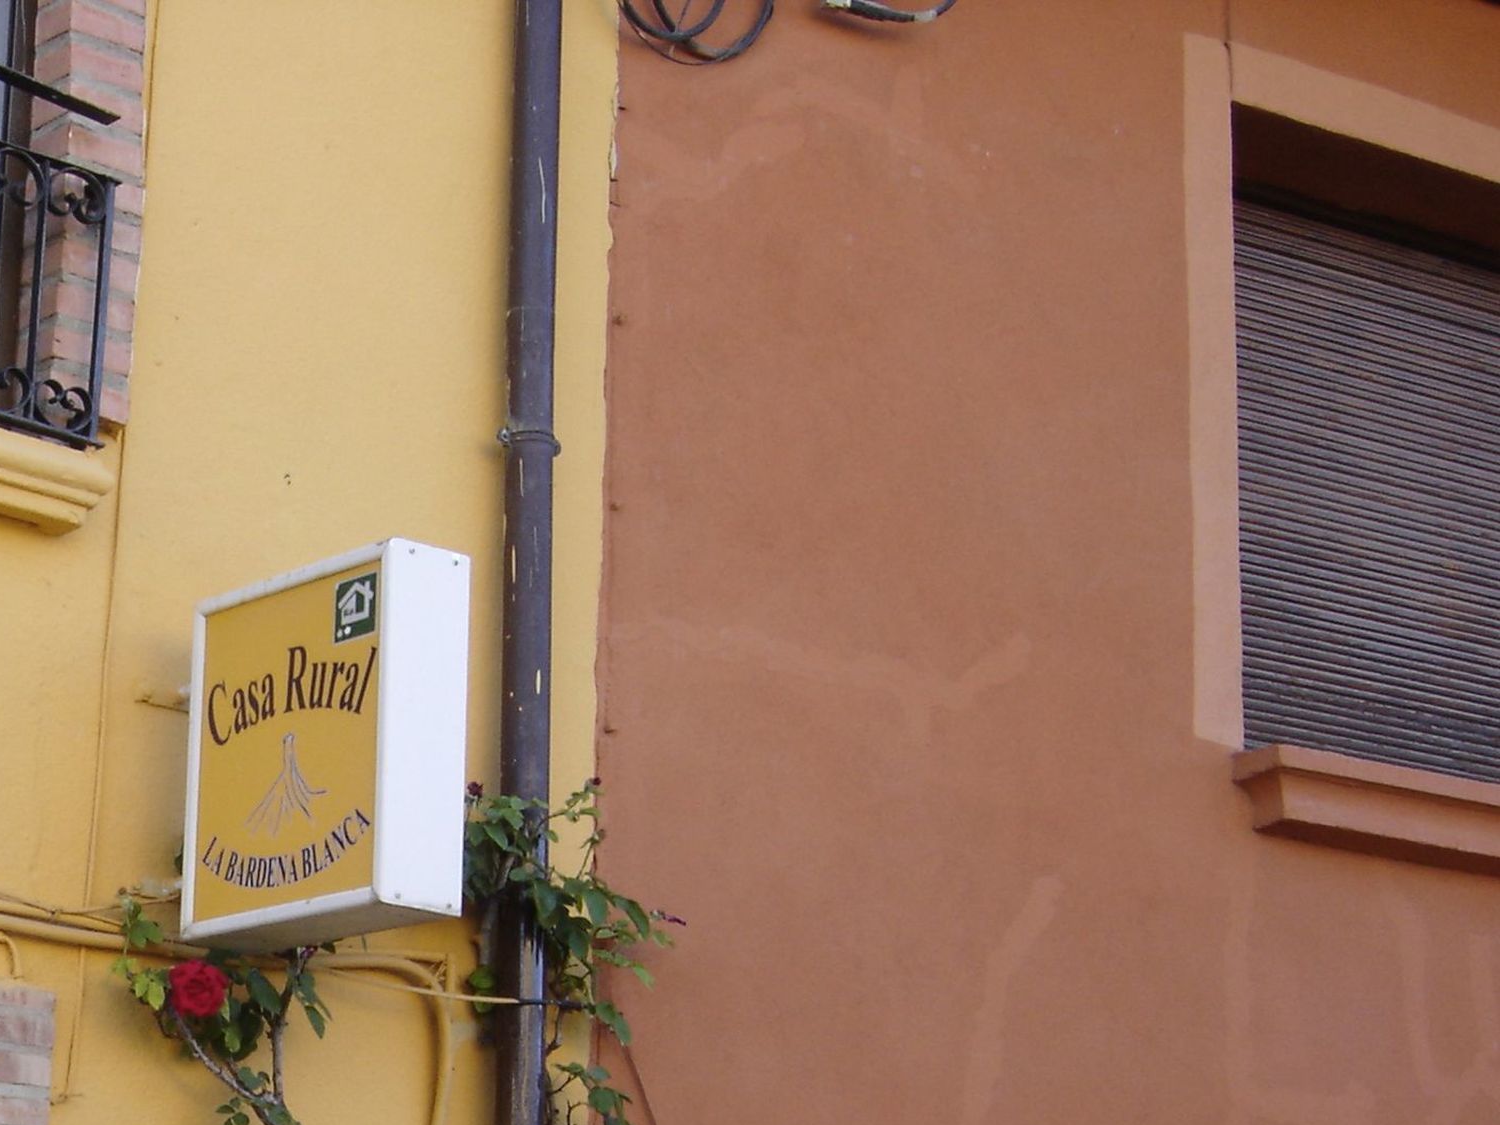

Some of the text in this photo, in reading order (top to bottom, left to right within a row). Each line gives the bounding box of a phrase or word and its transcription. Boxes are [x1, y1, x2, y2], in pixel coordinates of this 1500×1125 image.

[208, 646, 377, 746] Casa Rural
[202, 808, 371, 888] LA BARDENA BLANCA
